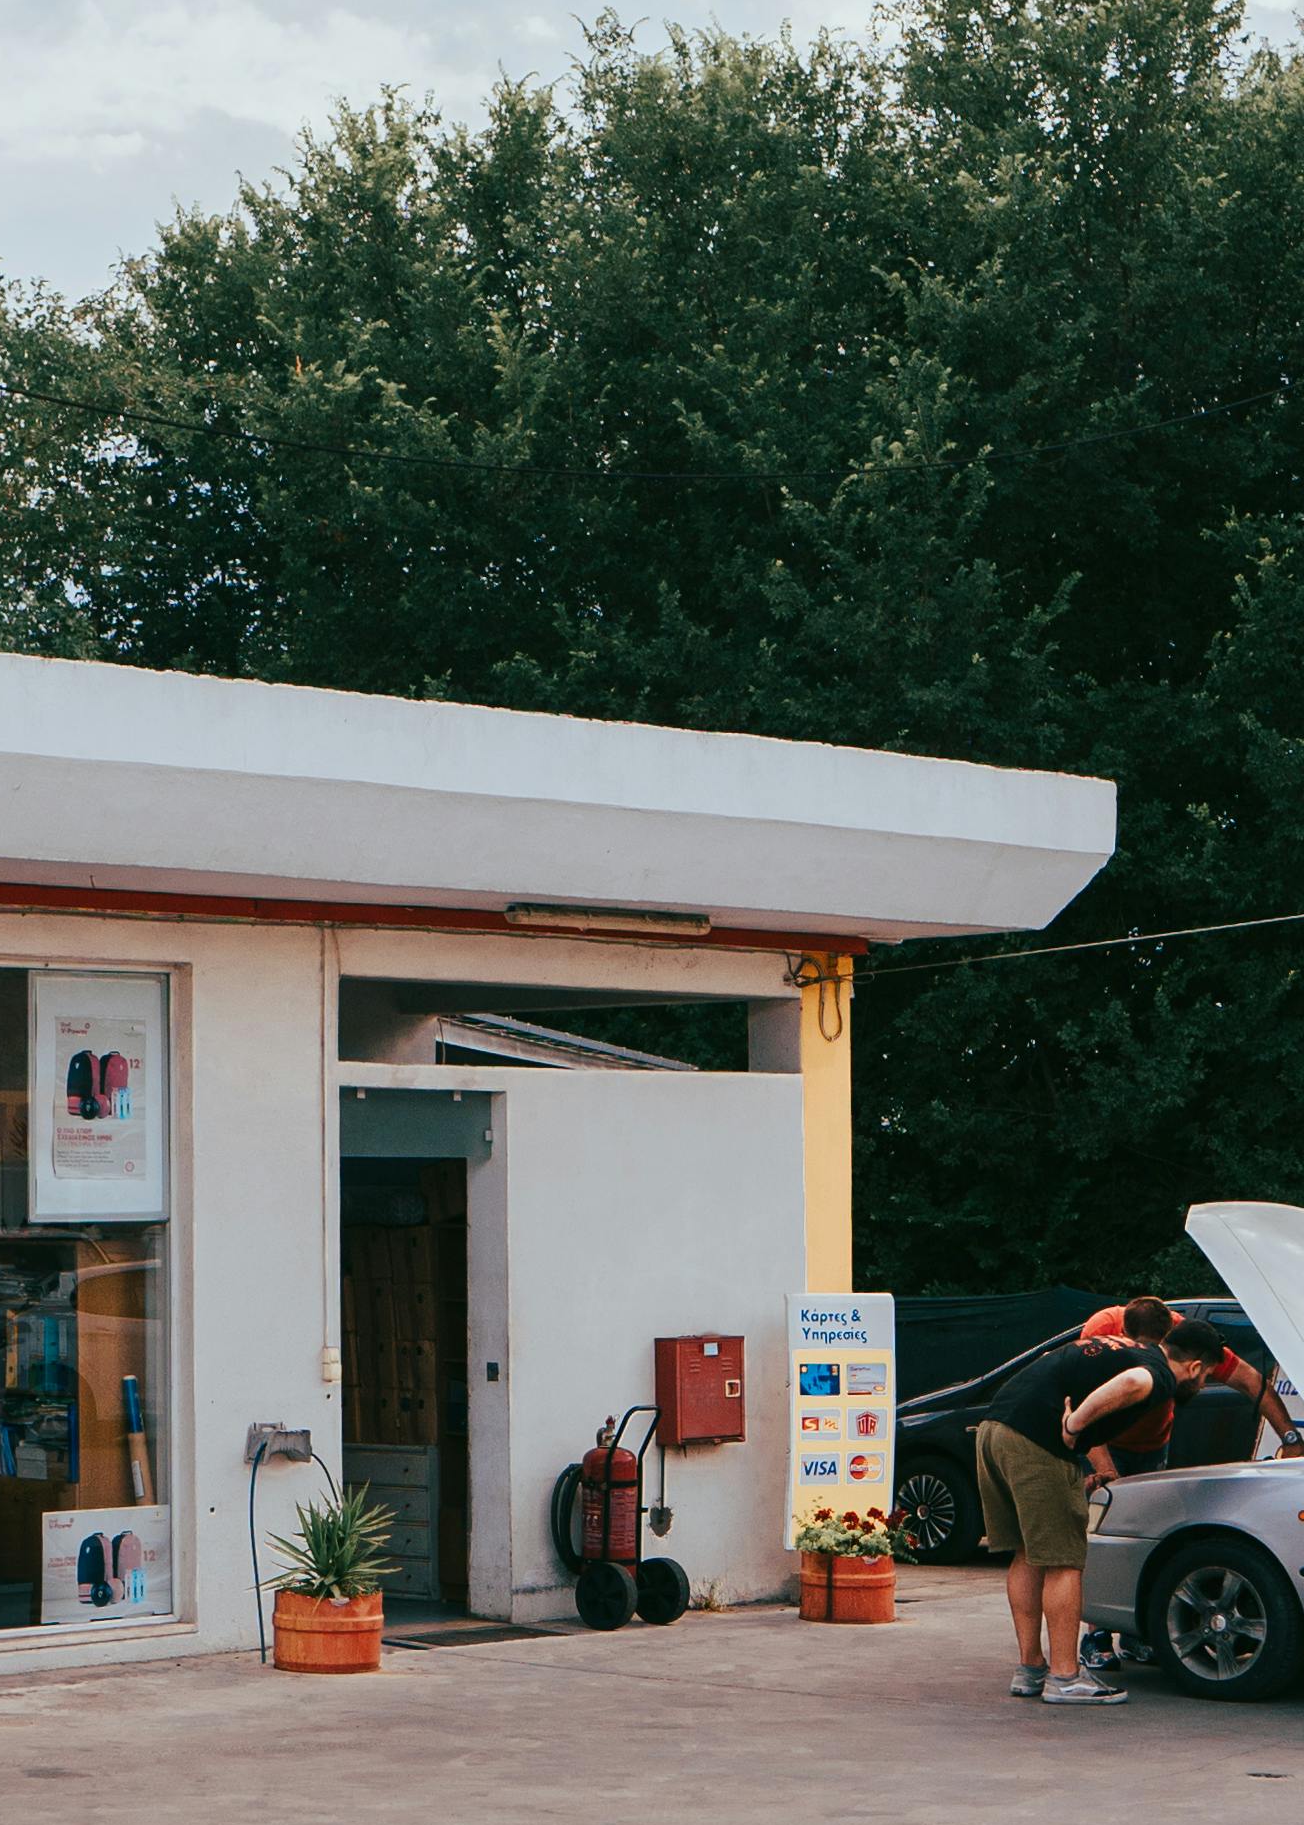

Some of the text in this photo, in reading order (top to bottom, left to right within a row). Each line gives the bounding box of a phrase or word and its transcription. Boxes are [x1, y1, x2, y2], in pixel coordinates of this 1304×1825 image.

[801, 1308, 861, 1326] Κάρτες &
[802, 1327, 868, 1344] Υπηρεσίες
[803, 1460, 838, 1476] VISA
